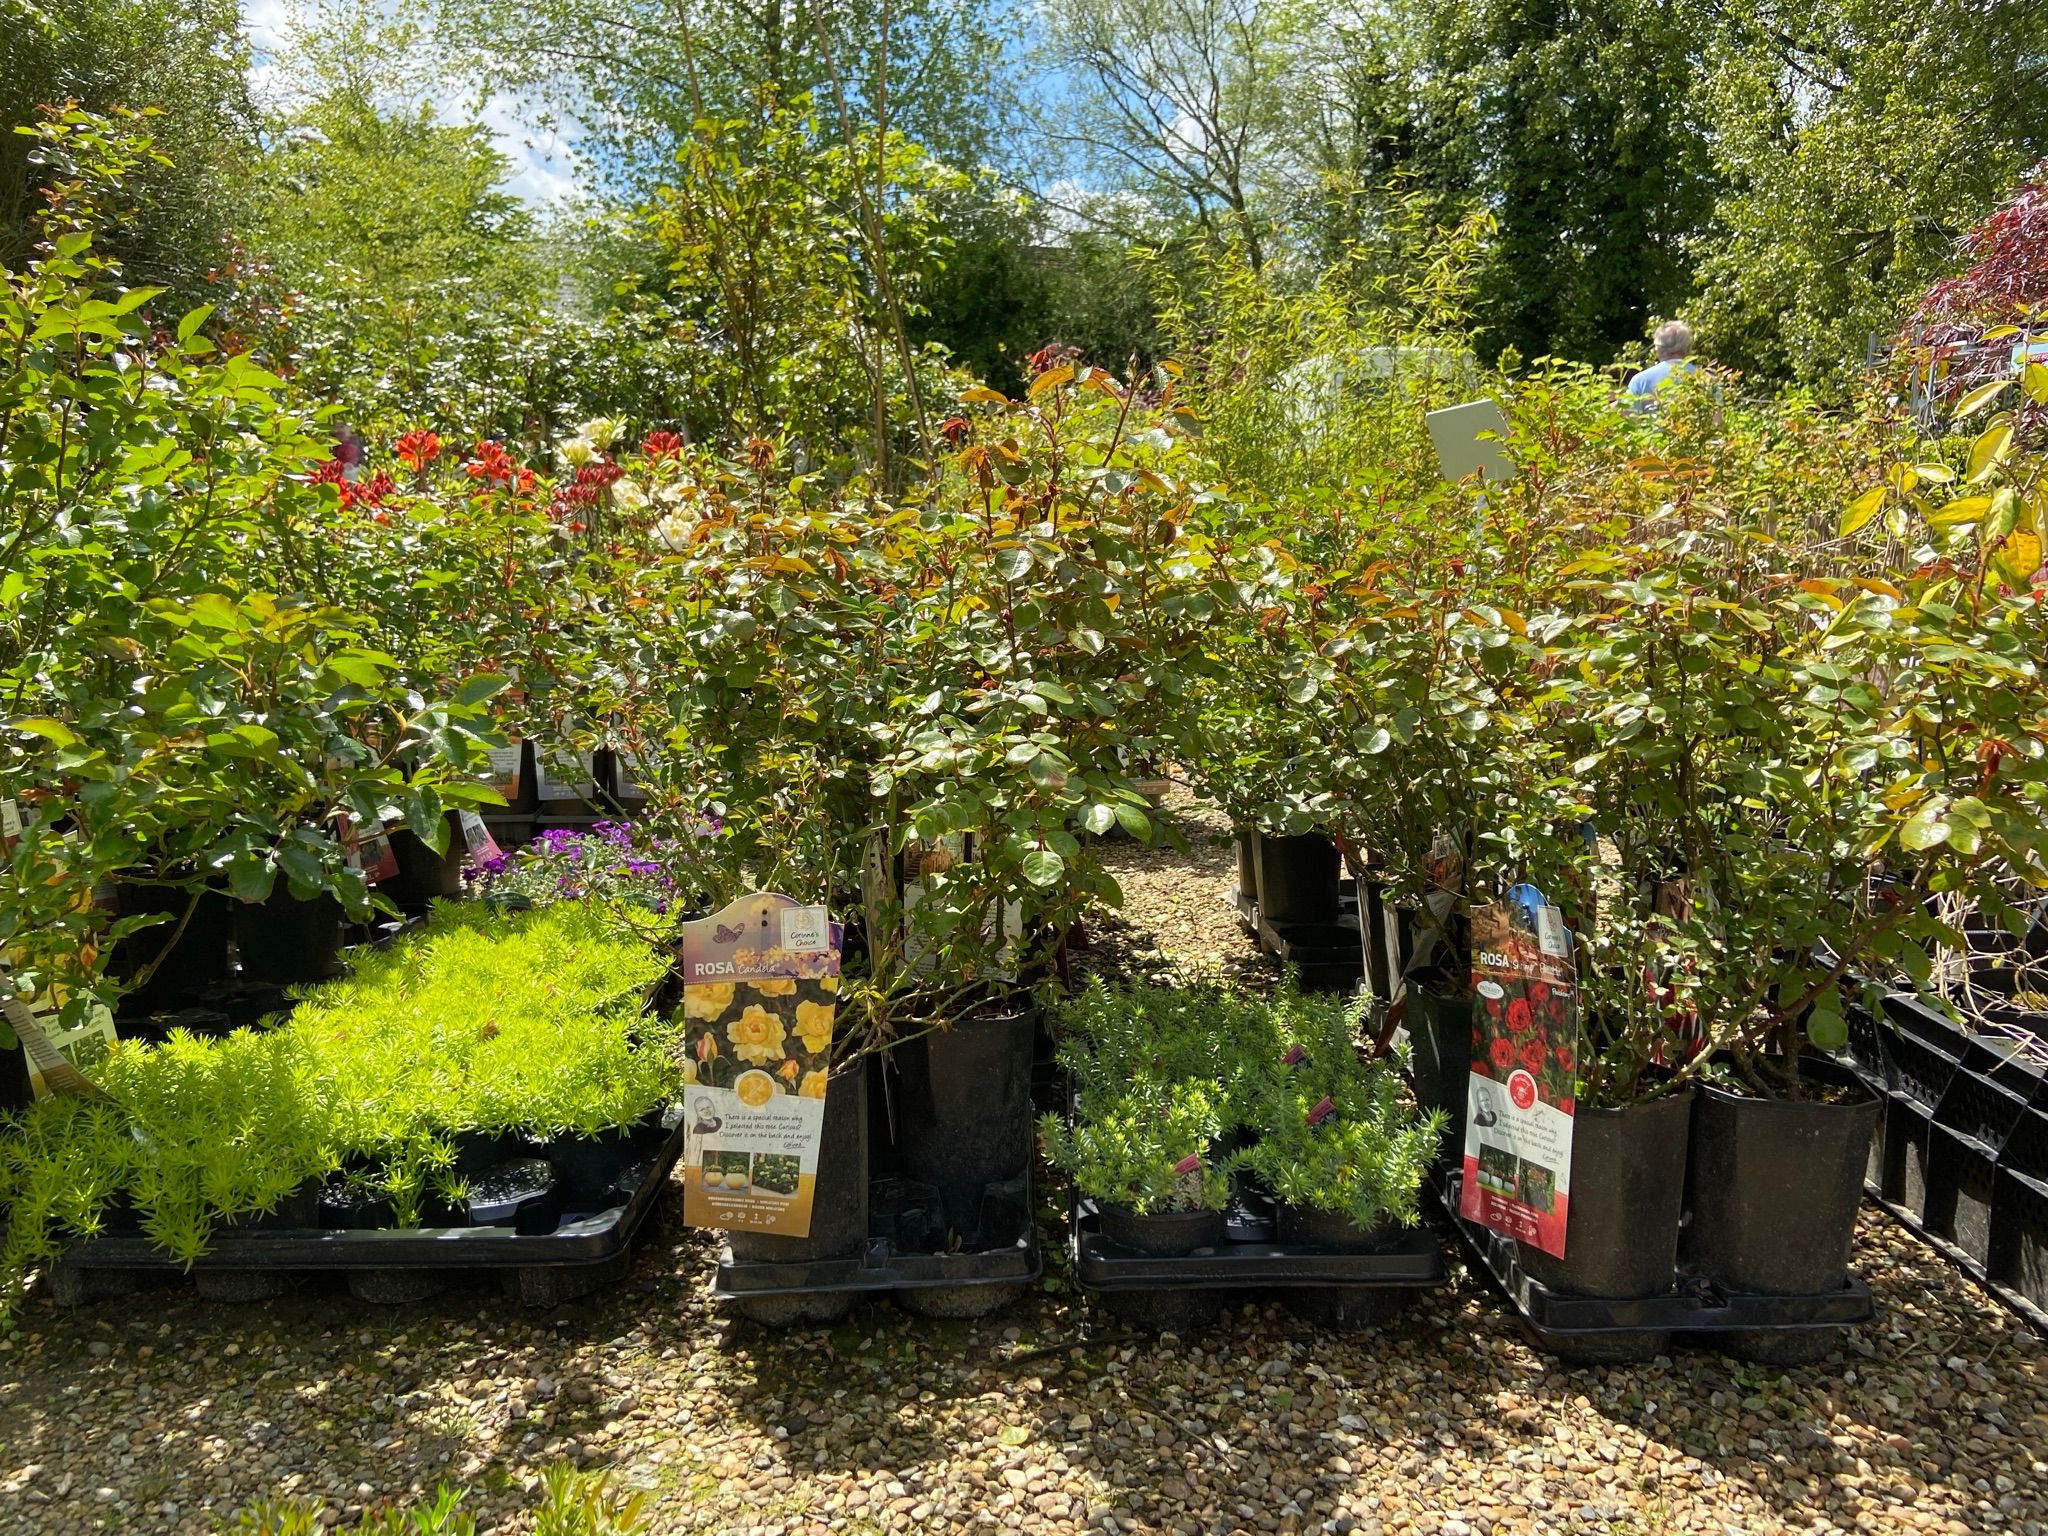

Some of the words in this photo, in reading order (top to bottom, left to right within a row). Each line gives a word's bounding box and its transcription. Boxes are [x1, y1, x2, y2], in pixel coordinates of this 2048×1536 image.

[1480, 951, 1510, 968] ROSA
[694, 961, 735, 976] ROSA
[753, 1114, 772, 1123] special
